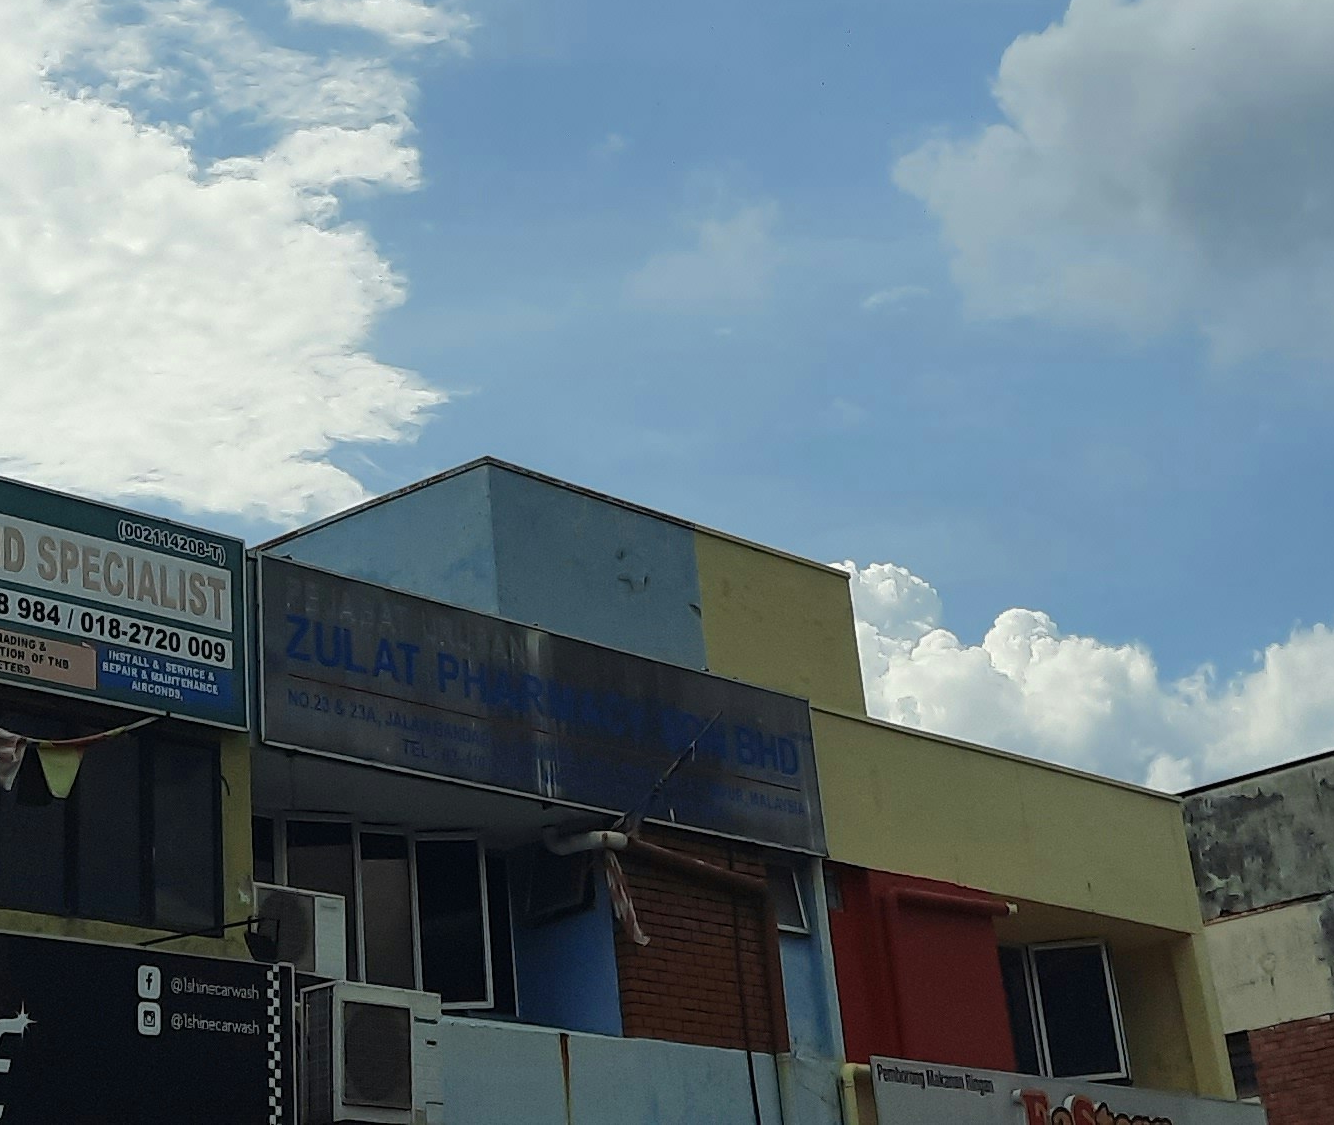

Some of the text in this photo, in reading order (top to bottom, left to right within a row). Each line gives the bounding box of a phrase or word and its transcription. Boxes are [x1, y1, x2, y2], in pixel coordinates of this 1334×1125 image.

[36, 535, 227, 621] SPECIALIST
[17, 599, 61, 626] 984
[67, 607, 75, 630] /
[80, 611, 181, 653] 018-2720
[187, 635, 226, 664] 009
[39, 642, 47, 652] &
[31, 653, 44, 664] OF
[108, 650, 149, 668] INSTALL
[165, 662, 205, 680] SERVICE
[102, 661, 138, 678] REPAIR
[150, 671, 219, 695] MAINTENANCE
[284, 613, 421, 687] ZULAT
[734, 723, 799, 776] BHD
